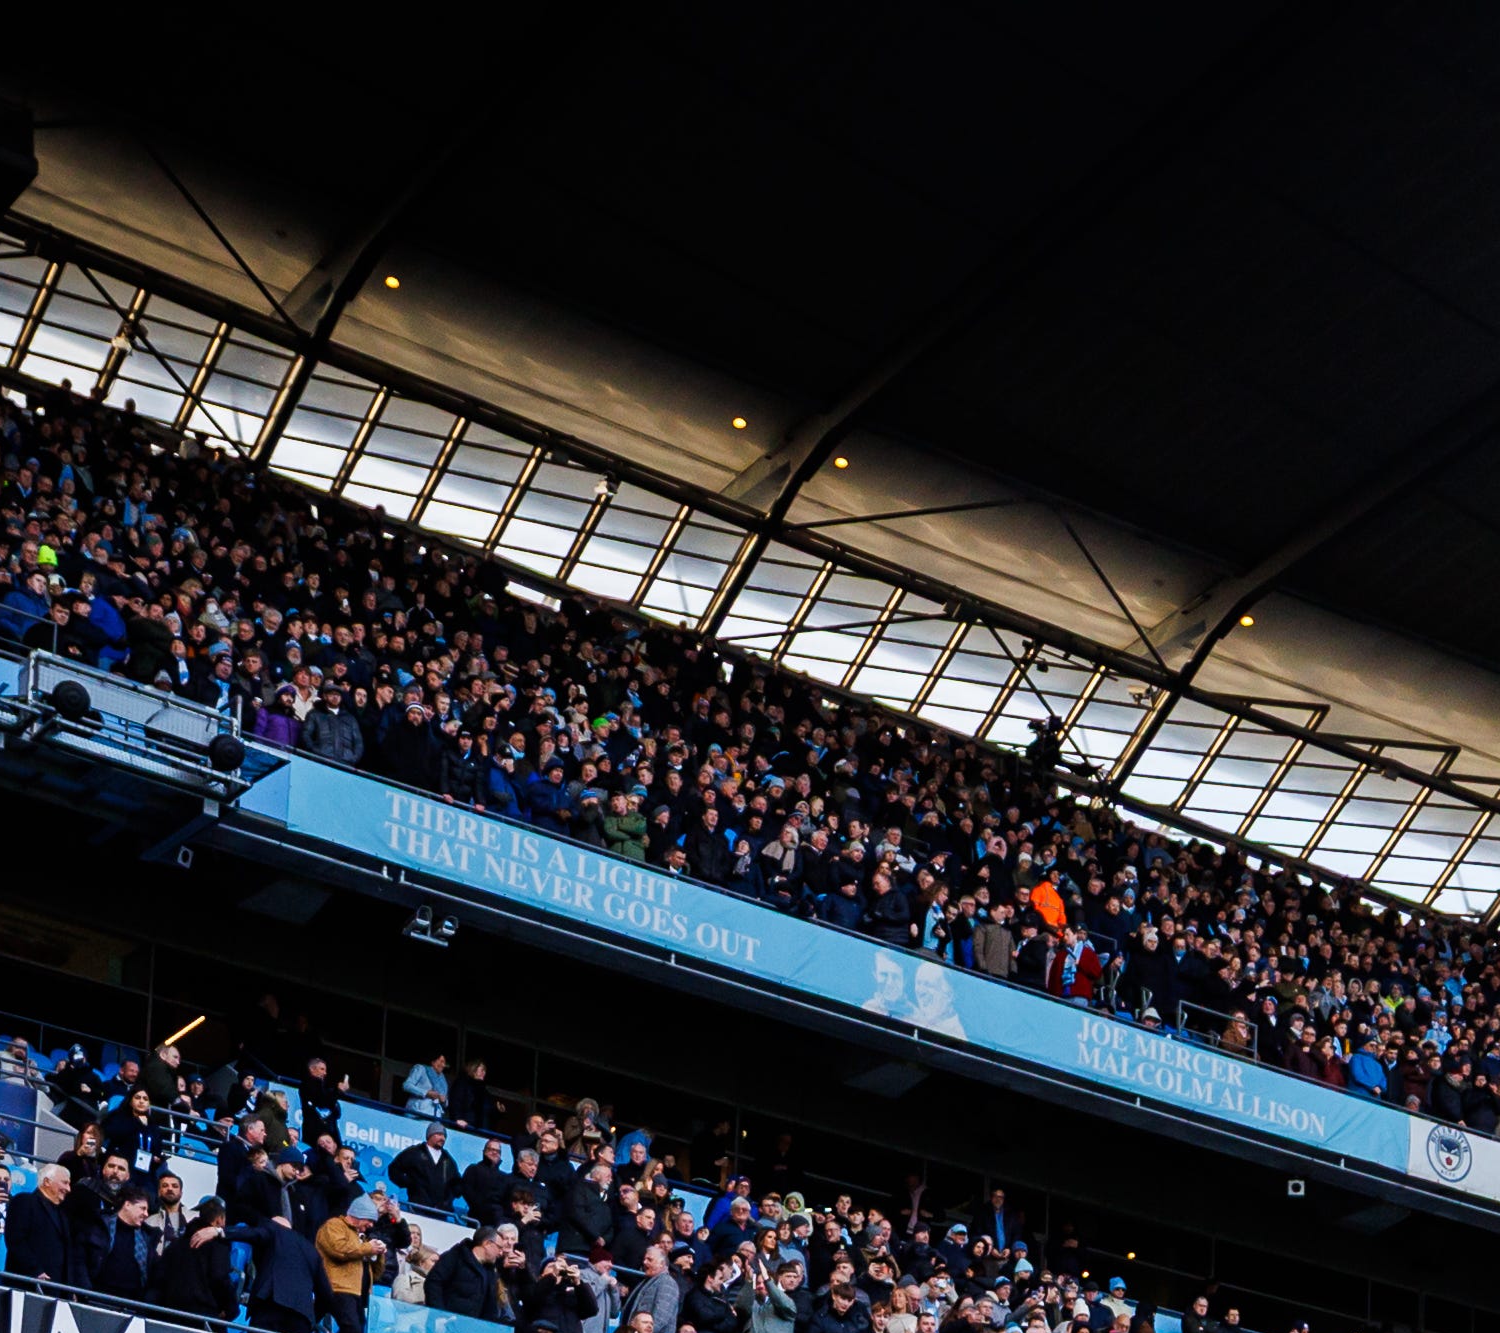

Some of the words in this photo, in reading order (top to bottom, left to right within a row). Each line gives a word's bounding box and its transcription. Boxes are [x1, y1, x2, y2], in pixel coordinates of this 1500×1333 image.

[384, 820, 477, 872] THAT
[484, 851, 596, 911] NEVER
[603, 894, 688, 939] GOES
[696, 922, 762, 963] OUT
[385, 790, 501, 851] THERE
[511, 831, 539, 863] IS
[548, 846, 570, 874] A
[578, 853, 678, 907] LIGHT
[1077, 1016, 1128, 1052] JOE
[1134, 1036, 1243, 1086] MERCER
[1077, 1040, 1213, 1105] MALCOLM
[1216, 1087, 1325, 1139] ALLISON
[345, 1121, 379, 1144] Bell
